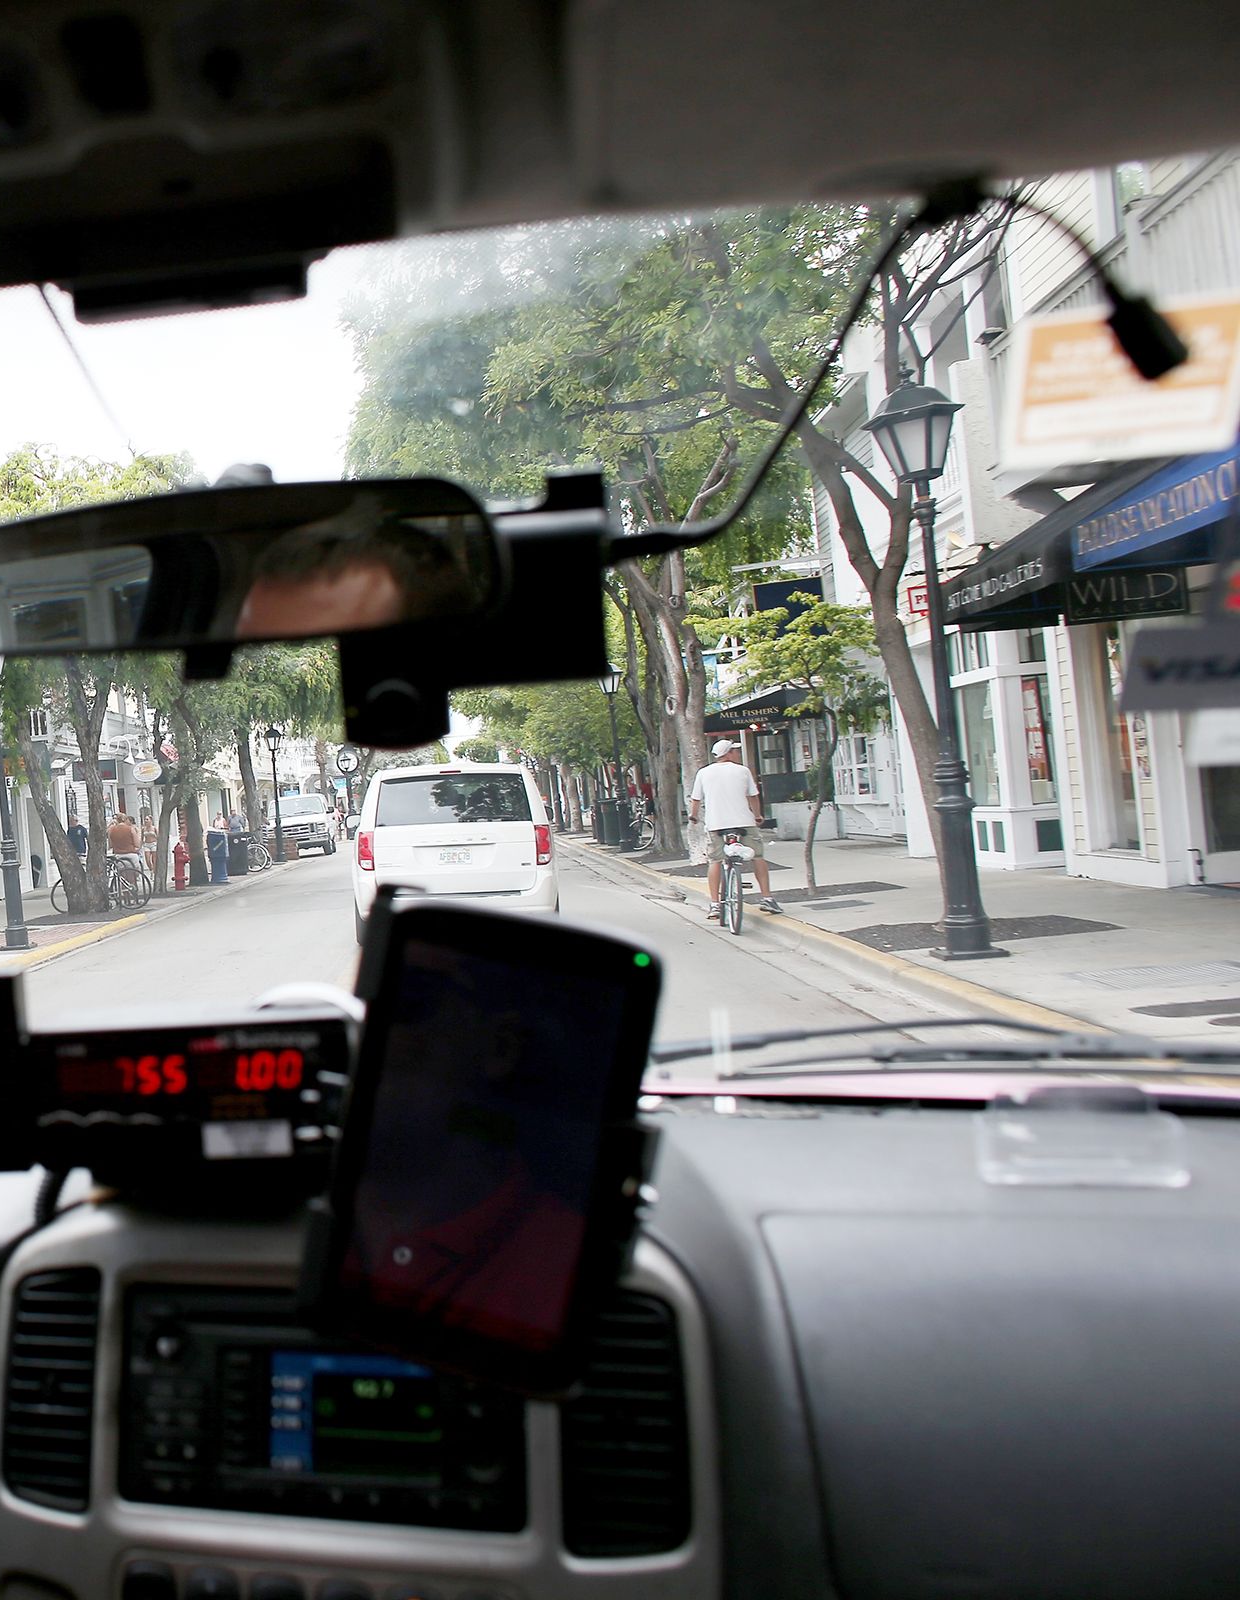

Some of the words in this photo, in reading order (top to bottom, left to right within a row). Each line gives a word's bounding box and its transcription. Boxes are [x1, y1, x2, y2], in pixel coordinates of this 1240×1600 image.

[1138, 470, 1215, 532] VACATION
[1071, 572, 1178, 605] WILD
[720, 711, 739, 719] MEL
[742, 706, 780, 717] FISHER'S
[732, 716, 769, 725] TREASURES
